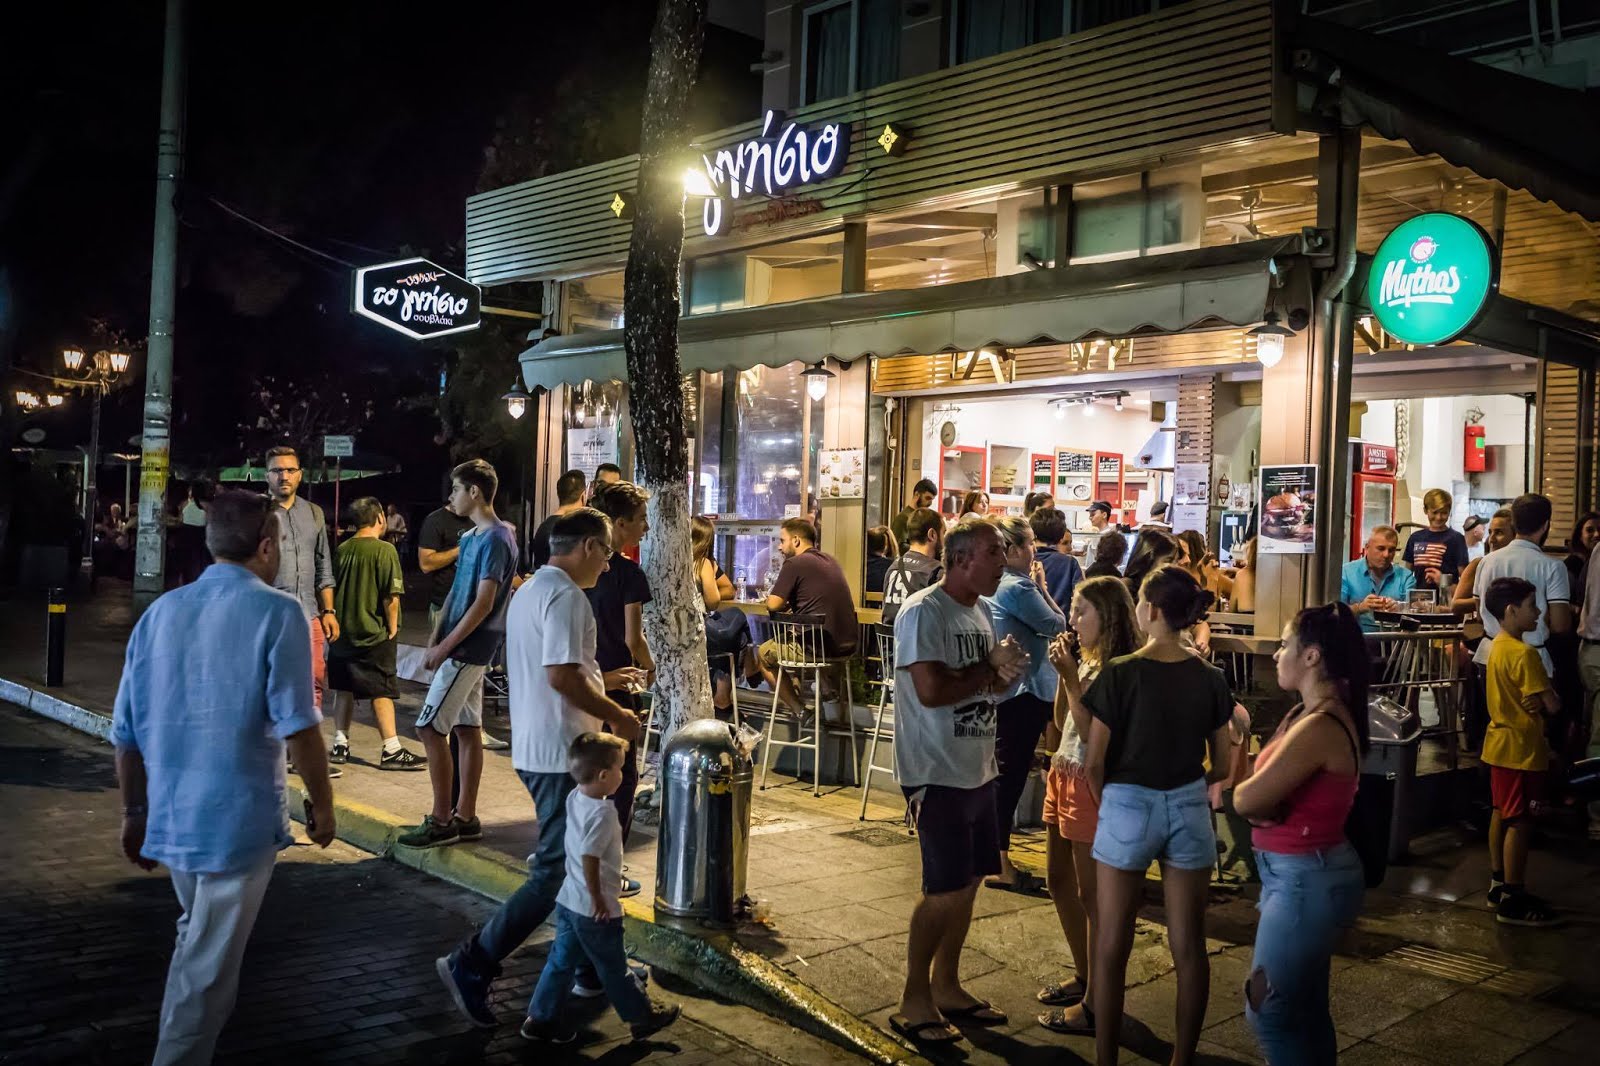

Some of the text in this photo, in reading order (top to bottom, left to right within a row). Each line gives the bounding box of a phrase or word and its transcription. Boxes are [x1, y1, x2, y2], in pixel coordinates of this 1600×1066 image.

[1379, 258, 1461, 308] Mythos
[372, 284, 469, 322] το γνήσιο
[413, 313, 454, 326] σουβλάκι
[1368, 447, 1388, 459] AMSTEL
